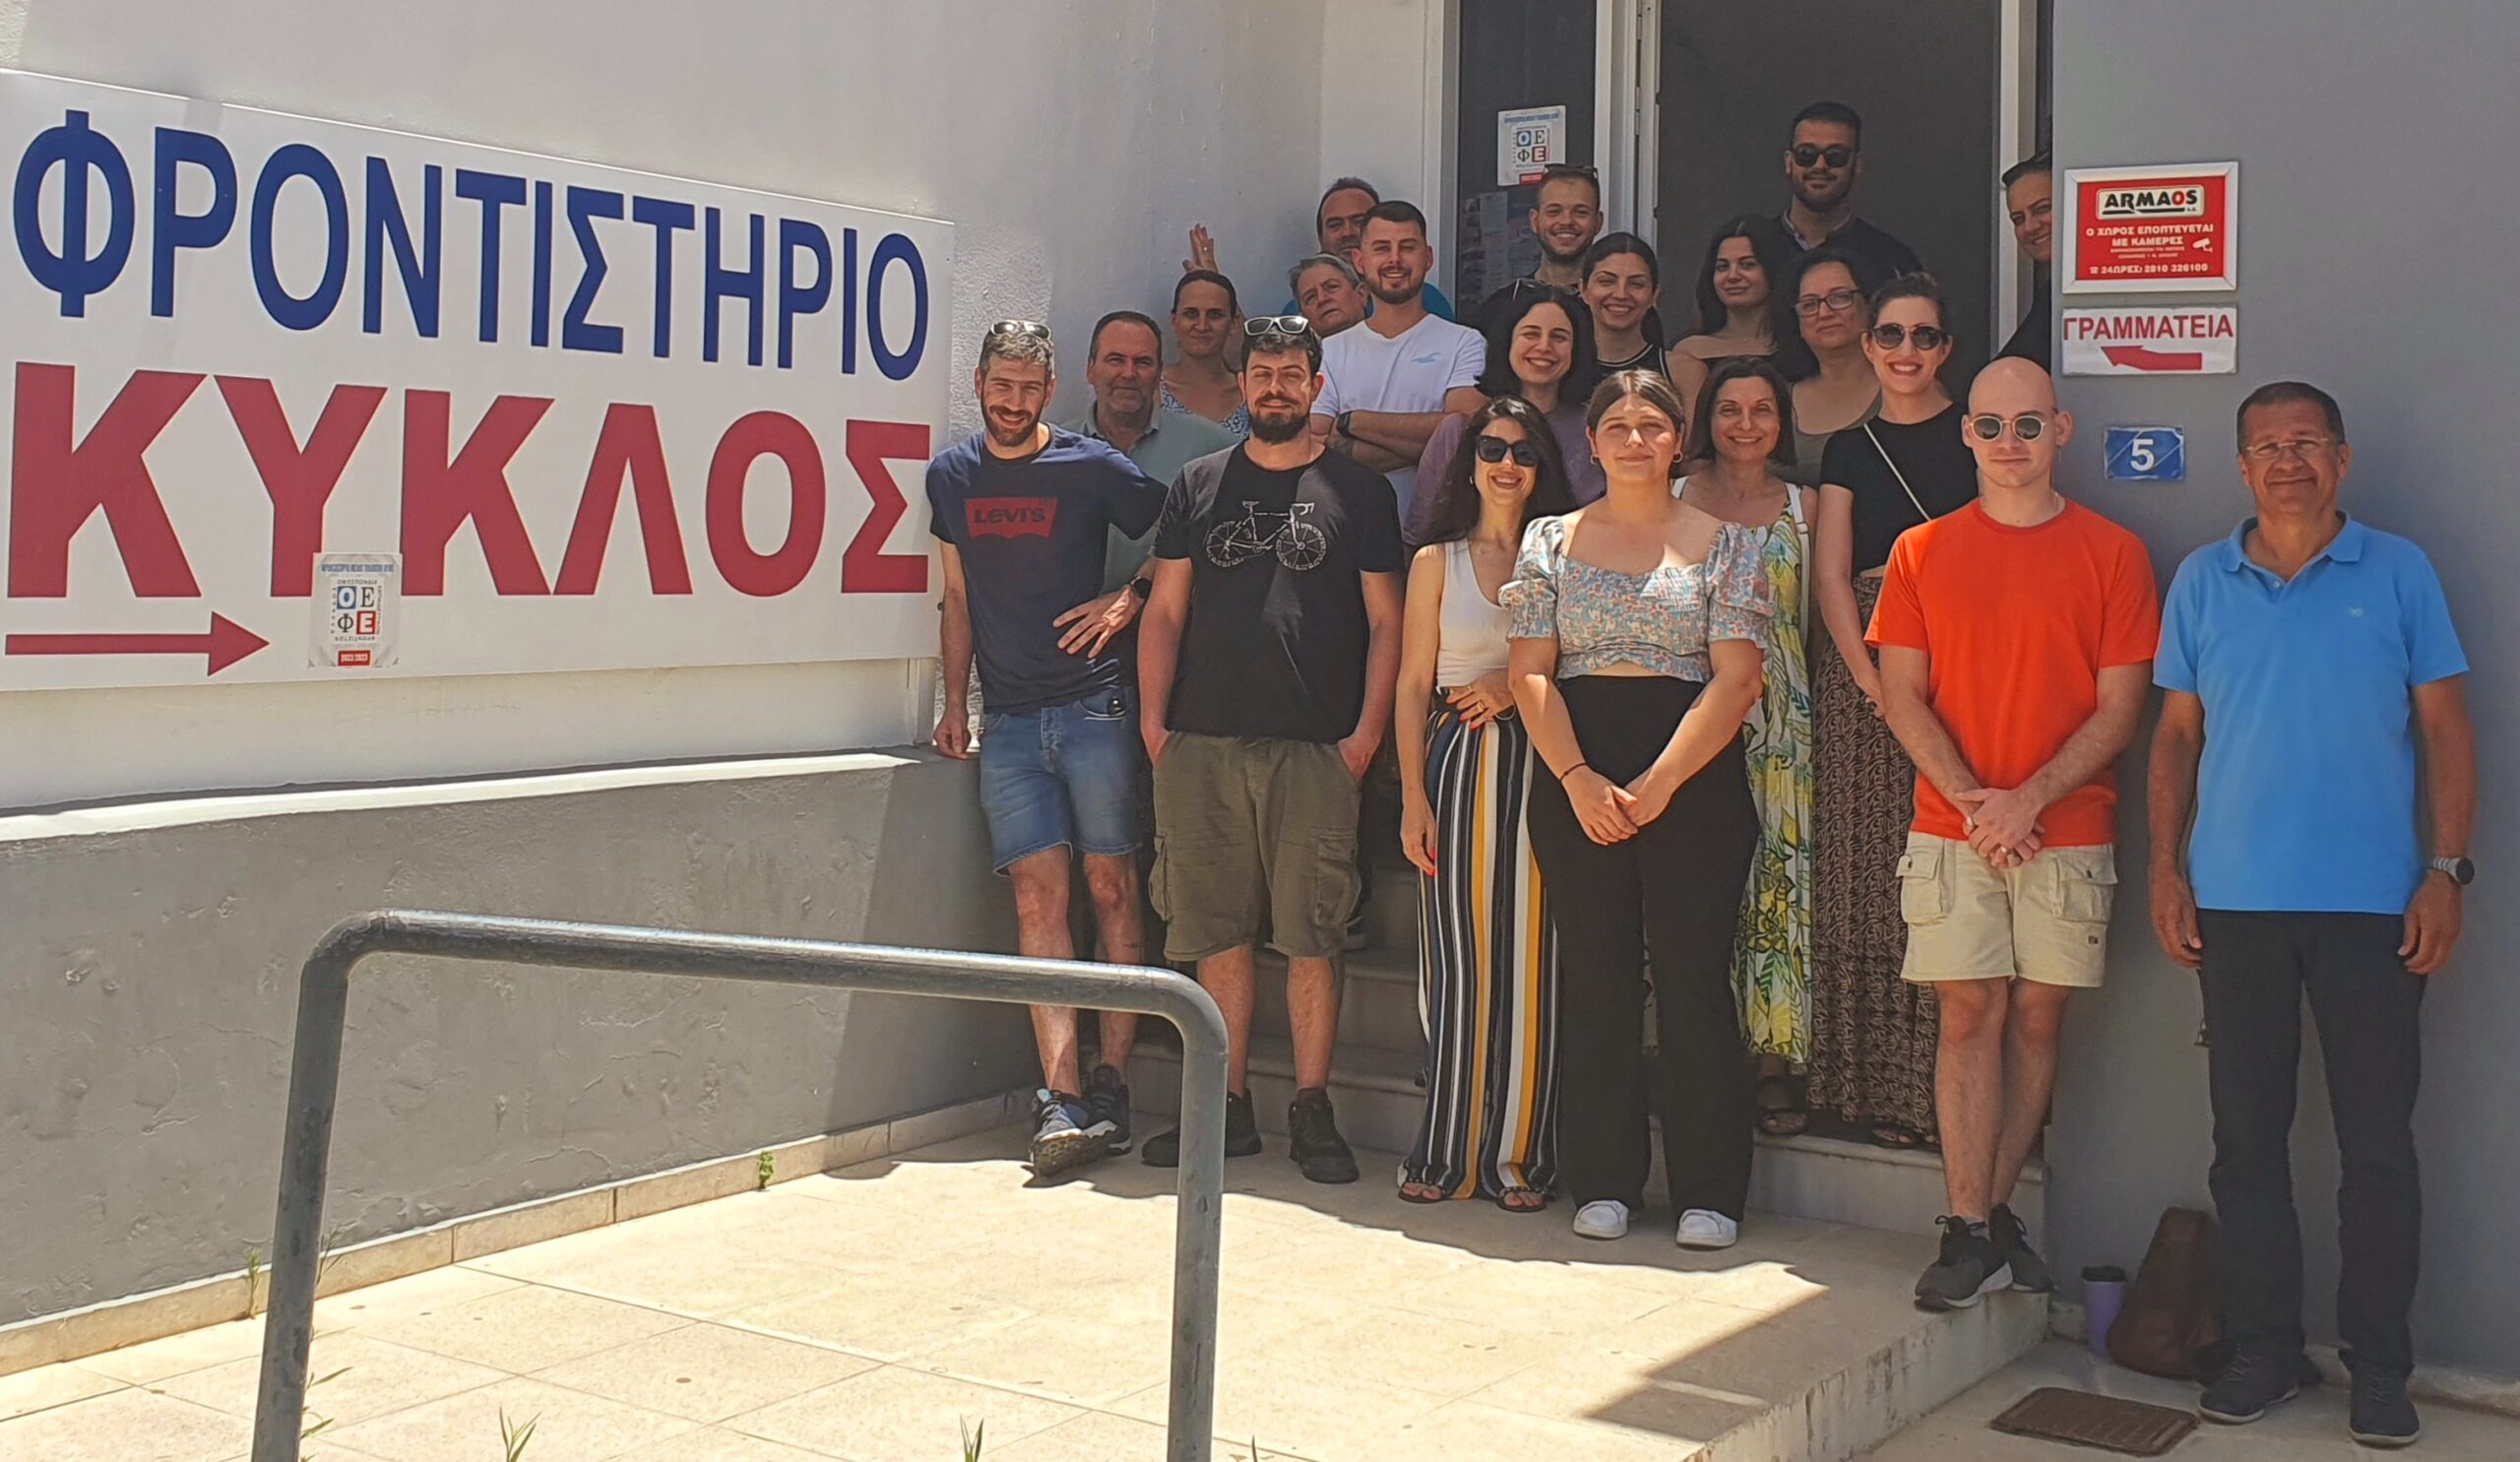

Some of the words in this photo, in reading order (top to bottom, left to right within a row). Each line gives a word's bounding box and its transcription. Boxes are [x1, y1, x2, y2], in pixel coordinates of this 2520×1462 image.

[2105, 189, 2198, 211] ARMAOS
[2086, 227, 2095, 236] Ο
[2097, 226, 2135, 236] ΧΩΡΟΣ
[2137, 223, 2214, 235] ΕΠΟΠΤΕΥΕΤΑΙ
[2111, 238, 2128, 247] ΜΕ
[2131, 236, 2183, 246] ΚΑΜΕΡΕΣ
[13, 109, 928, 381] ΦΡΟΝΤΙΣΤΗΡΙΟ
[2144, 264, 2169, 274] 2810
[2063, 314, 2234, 341] ΓΡΑΜΜΑΤΕΙΑ
[2130, 438, 2155, 472] 5
[8, 360, 930, 599] ΚΥΚΛΟΣ
